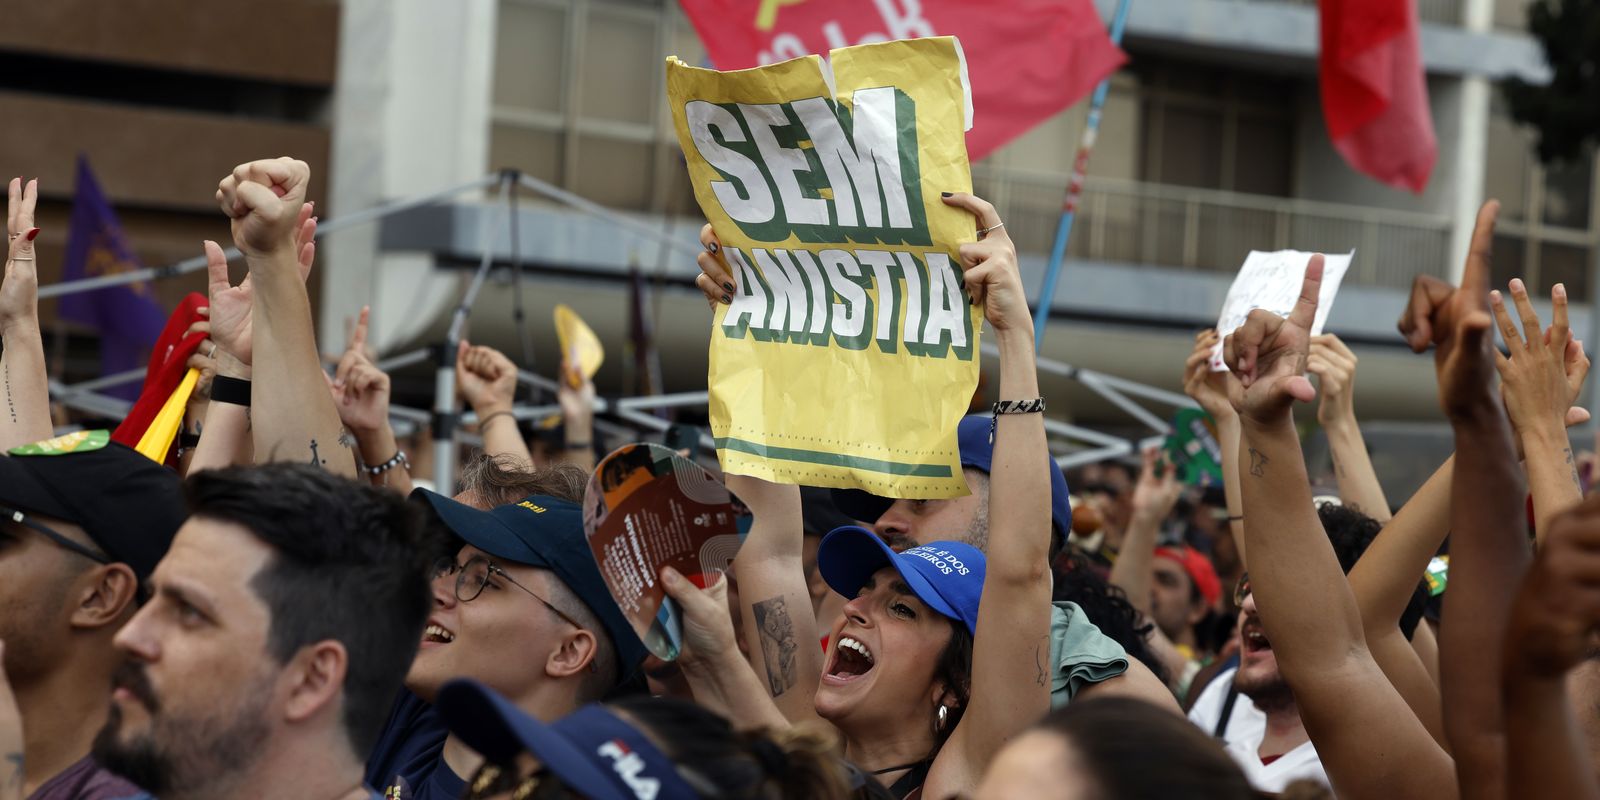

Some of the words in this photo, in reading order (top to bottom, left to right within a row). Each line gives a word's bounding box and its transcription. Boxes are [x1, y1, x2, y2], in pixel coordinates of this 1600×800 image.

[684, 86, 918, 233] SEM
[721, 247, 968, 350] ANISTIA
[944, 555, 970, 576] DOS
[597, 738, 661, 800] FILA
